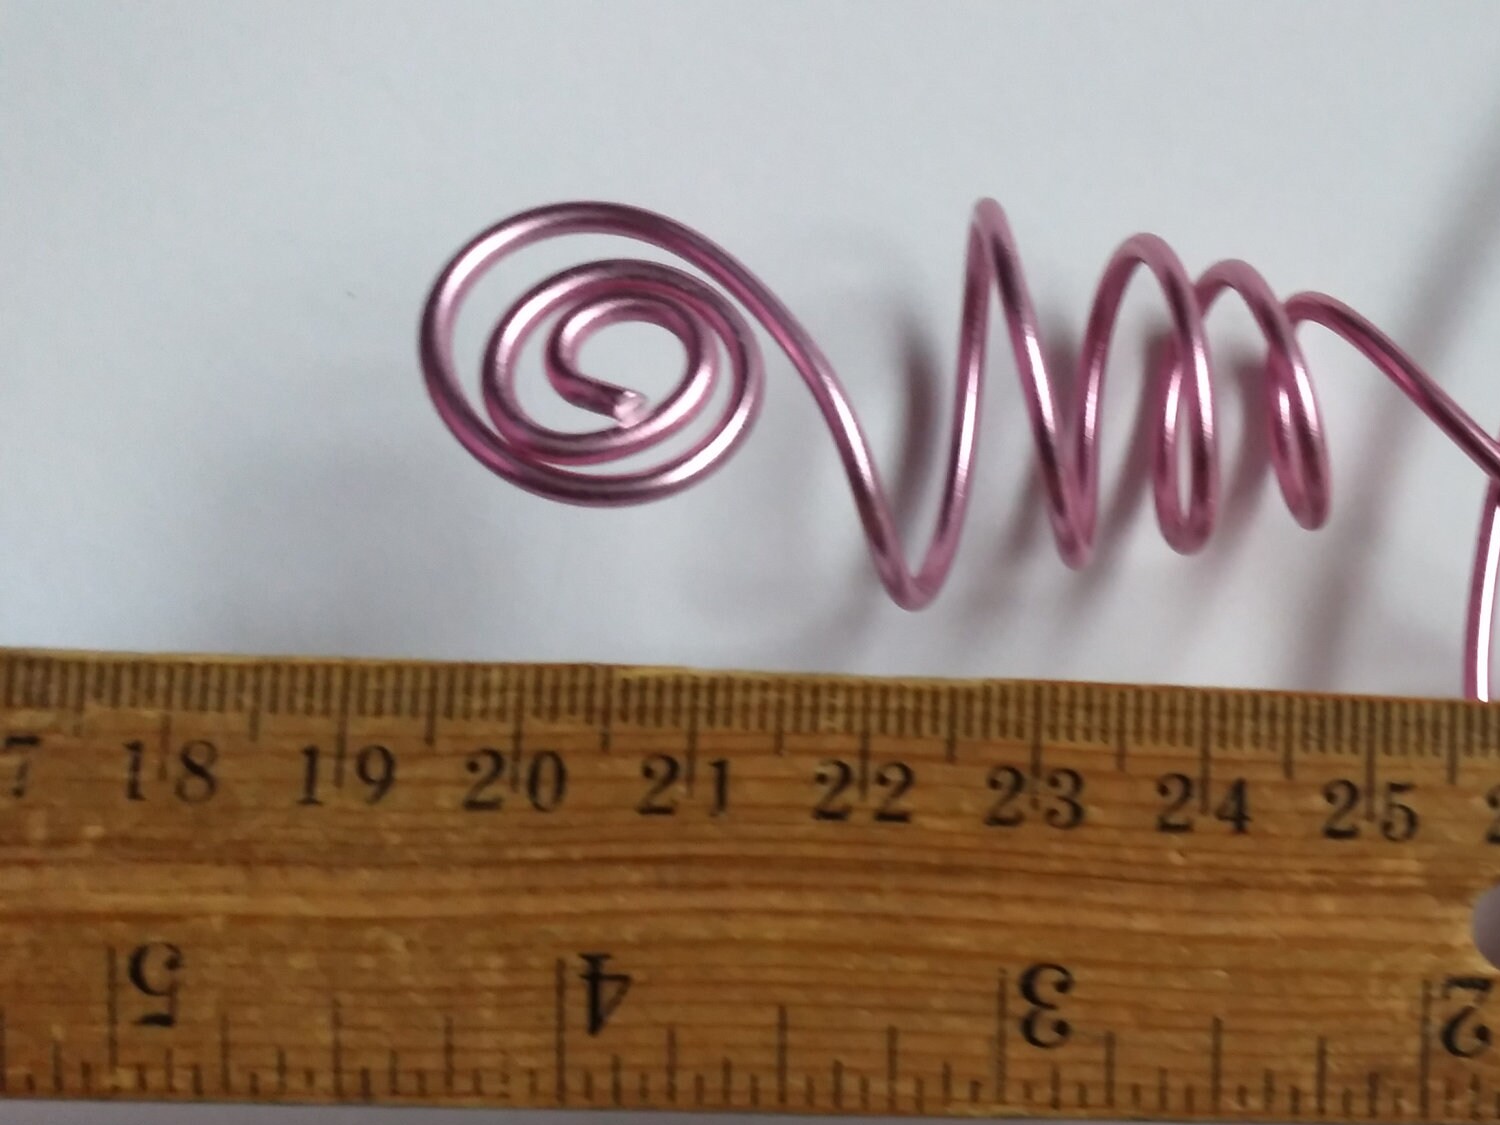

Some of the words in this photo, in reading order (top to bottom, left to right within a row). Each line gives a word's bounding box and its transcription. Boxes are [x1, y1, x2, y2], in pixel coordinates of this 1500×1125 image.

[121, 739, 219, 805] 18
[299, 744, 396, 806] 19
[463, 748, 567, 813] 20
[638, 754, 731, 819] 21
[811, 760, 915, 823] 22
[983, 765, 1086, 831] 23
[1155, 773, 1252, 835] 24
[1321, 778, 1419, 842] 25
[127, 942, 184, 1028] 5
[577, 952, 634, 1037] 4
[1017, 961, 1074, 1050] 3
[1440, 975, 1494, 1059] 2
